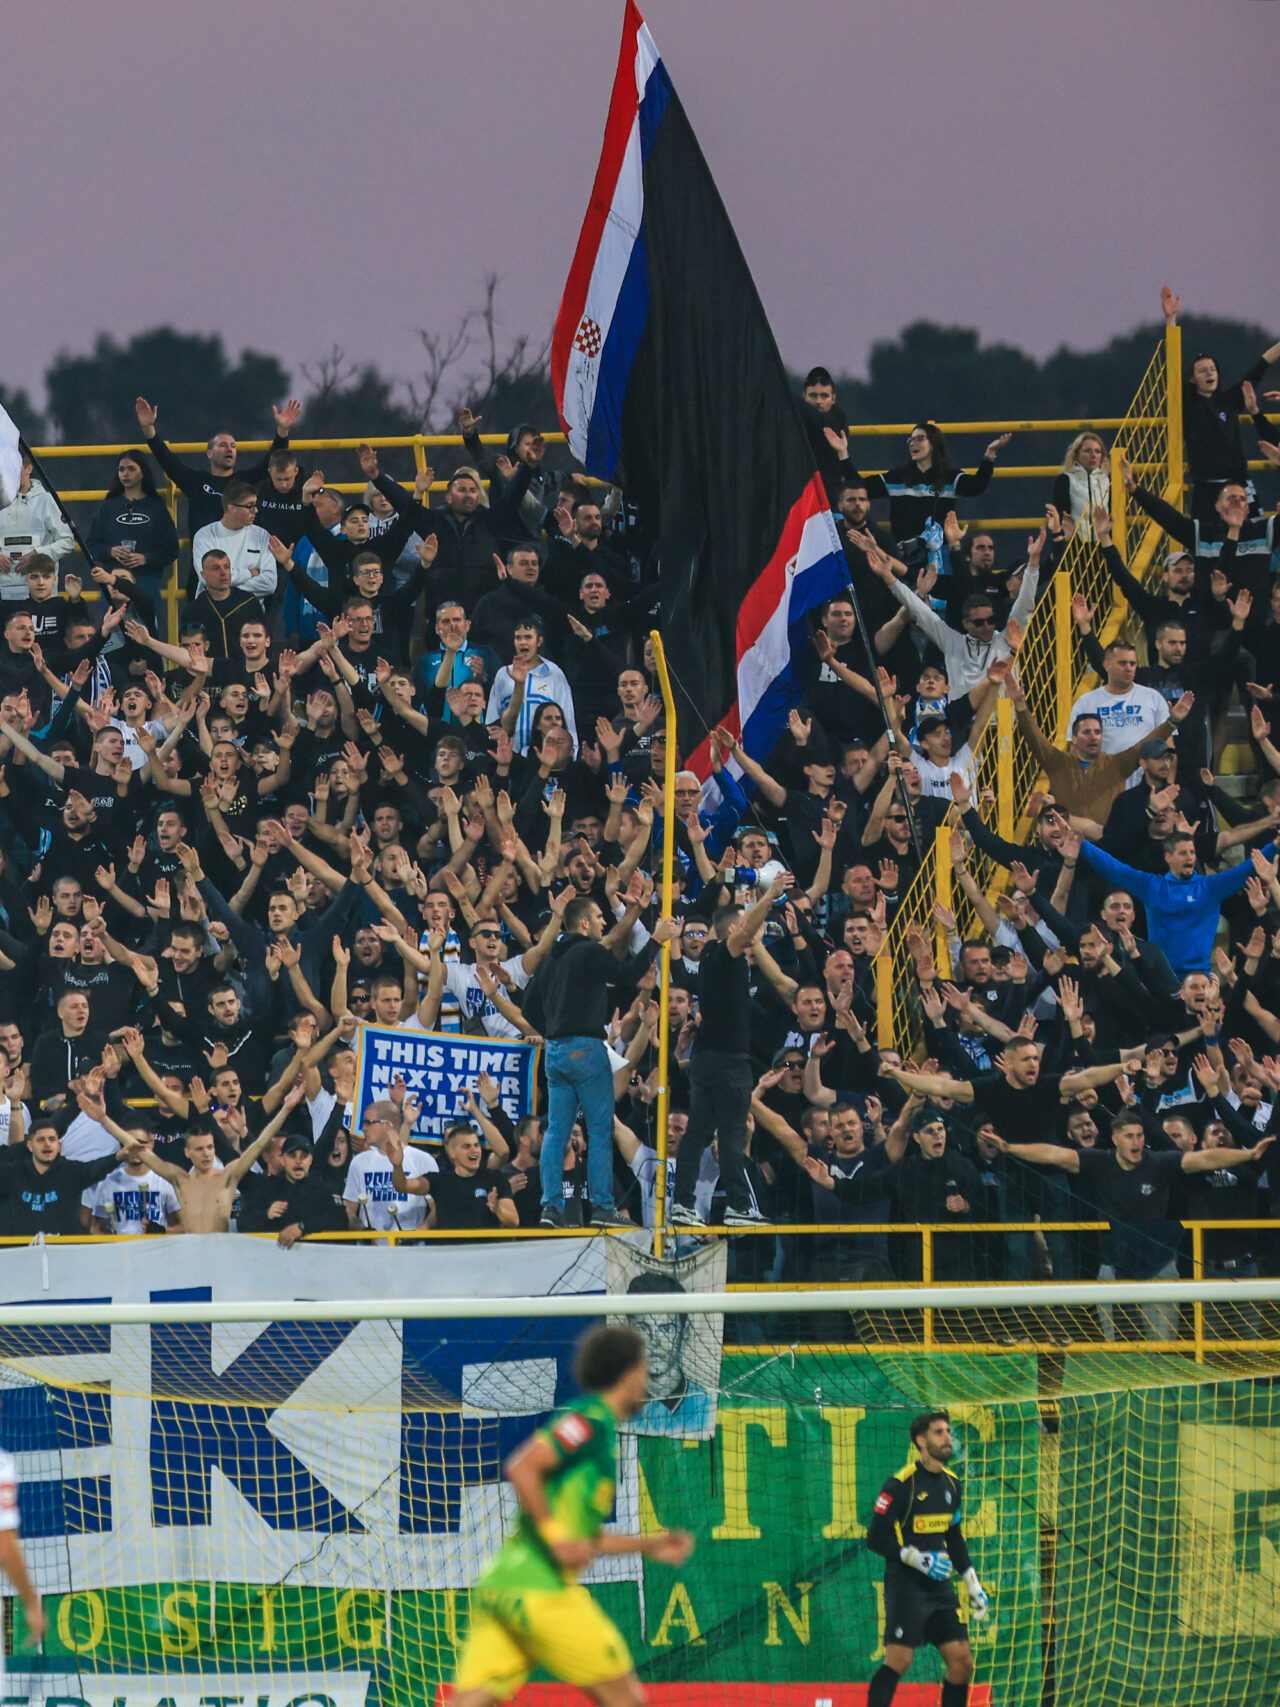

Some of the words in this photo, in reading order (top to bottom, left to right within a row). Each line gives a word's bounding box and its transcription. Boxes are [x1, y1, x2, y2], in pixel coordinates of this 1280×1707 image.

[373, 1039, 445, 1068] THIS
[450, 1048, 522, 1073] TIME
[371, 1064, 444, 1091] NEXT
